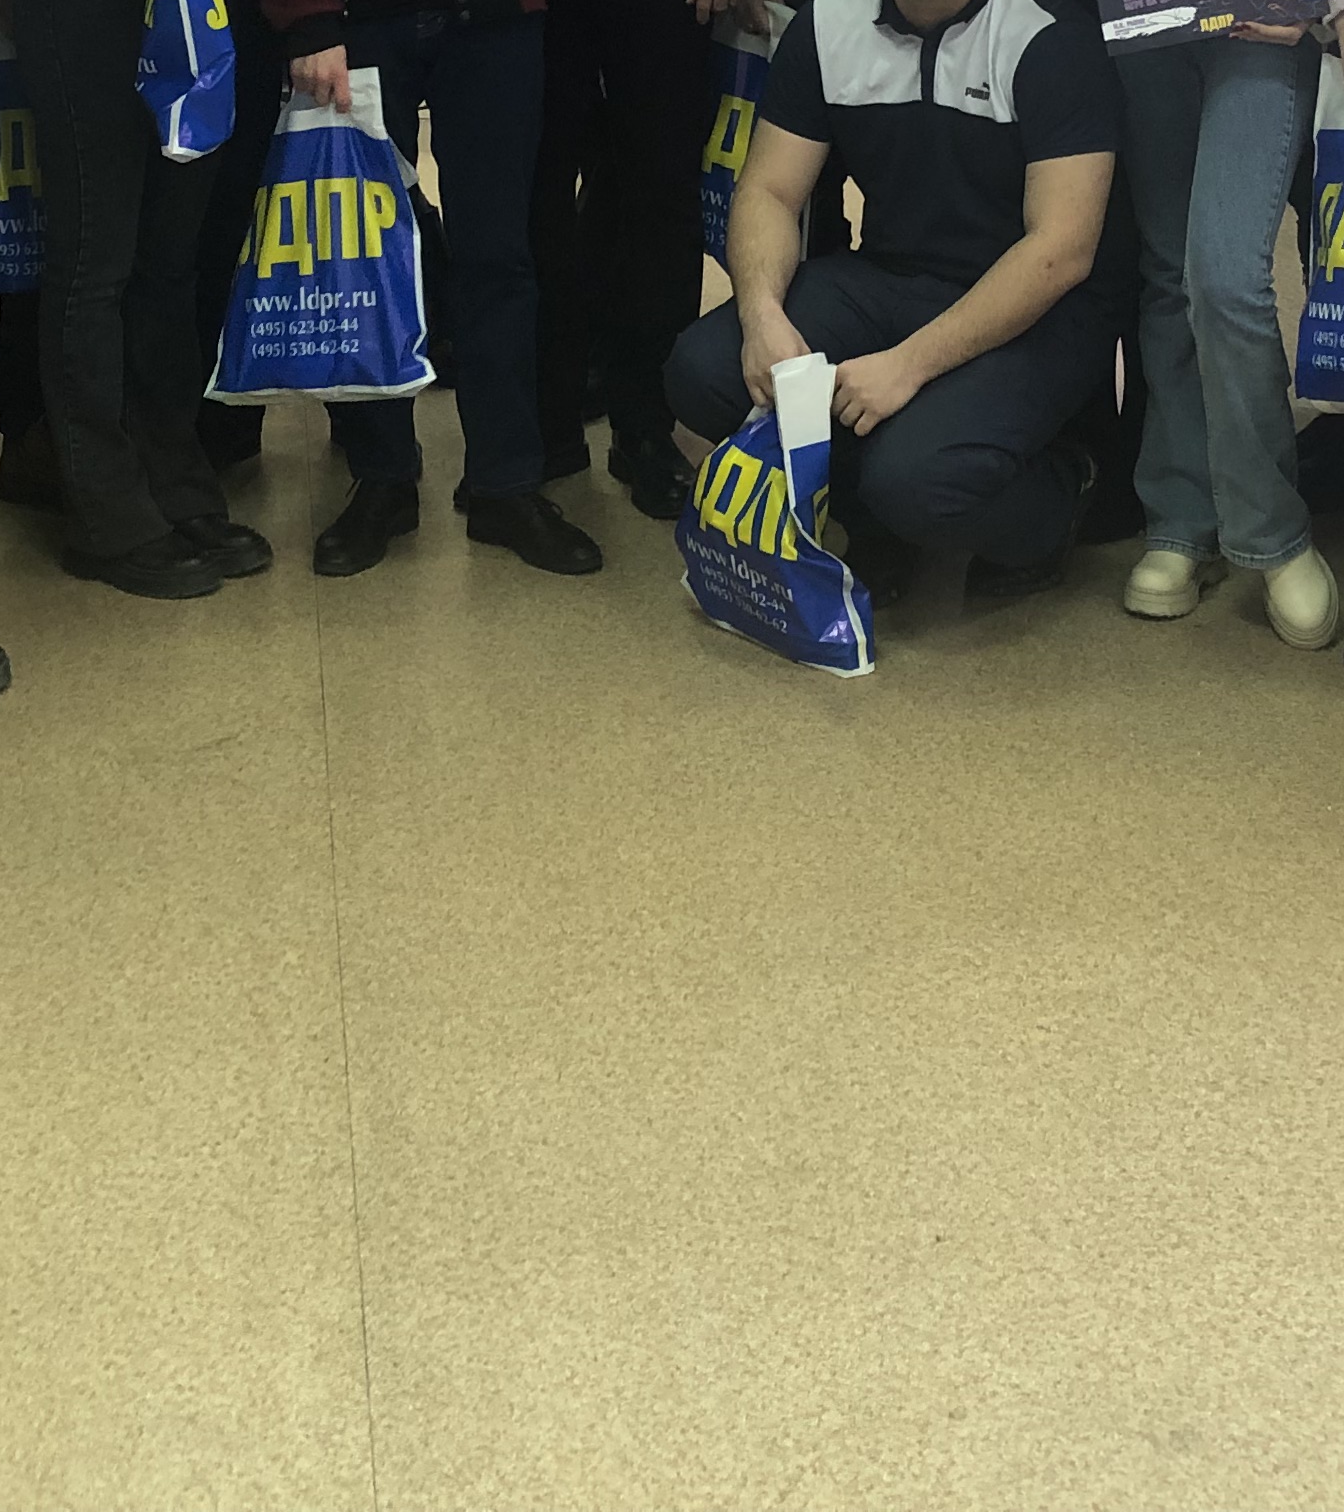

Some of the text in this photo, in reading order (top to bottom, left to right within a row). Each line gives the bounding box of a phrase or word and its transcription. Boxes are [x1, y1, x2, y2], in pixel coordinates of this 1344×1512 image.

[1200, 13, 1235, 33] ЛДПР
[246, 286, 377, 317] www.ldpr.ru
[250, 317, 359, 338] (495) 623-02-44
[252, 338, 360, 358] (495) 530-62-62
[686, 533, 793, 603] www.ldpr.ru
